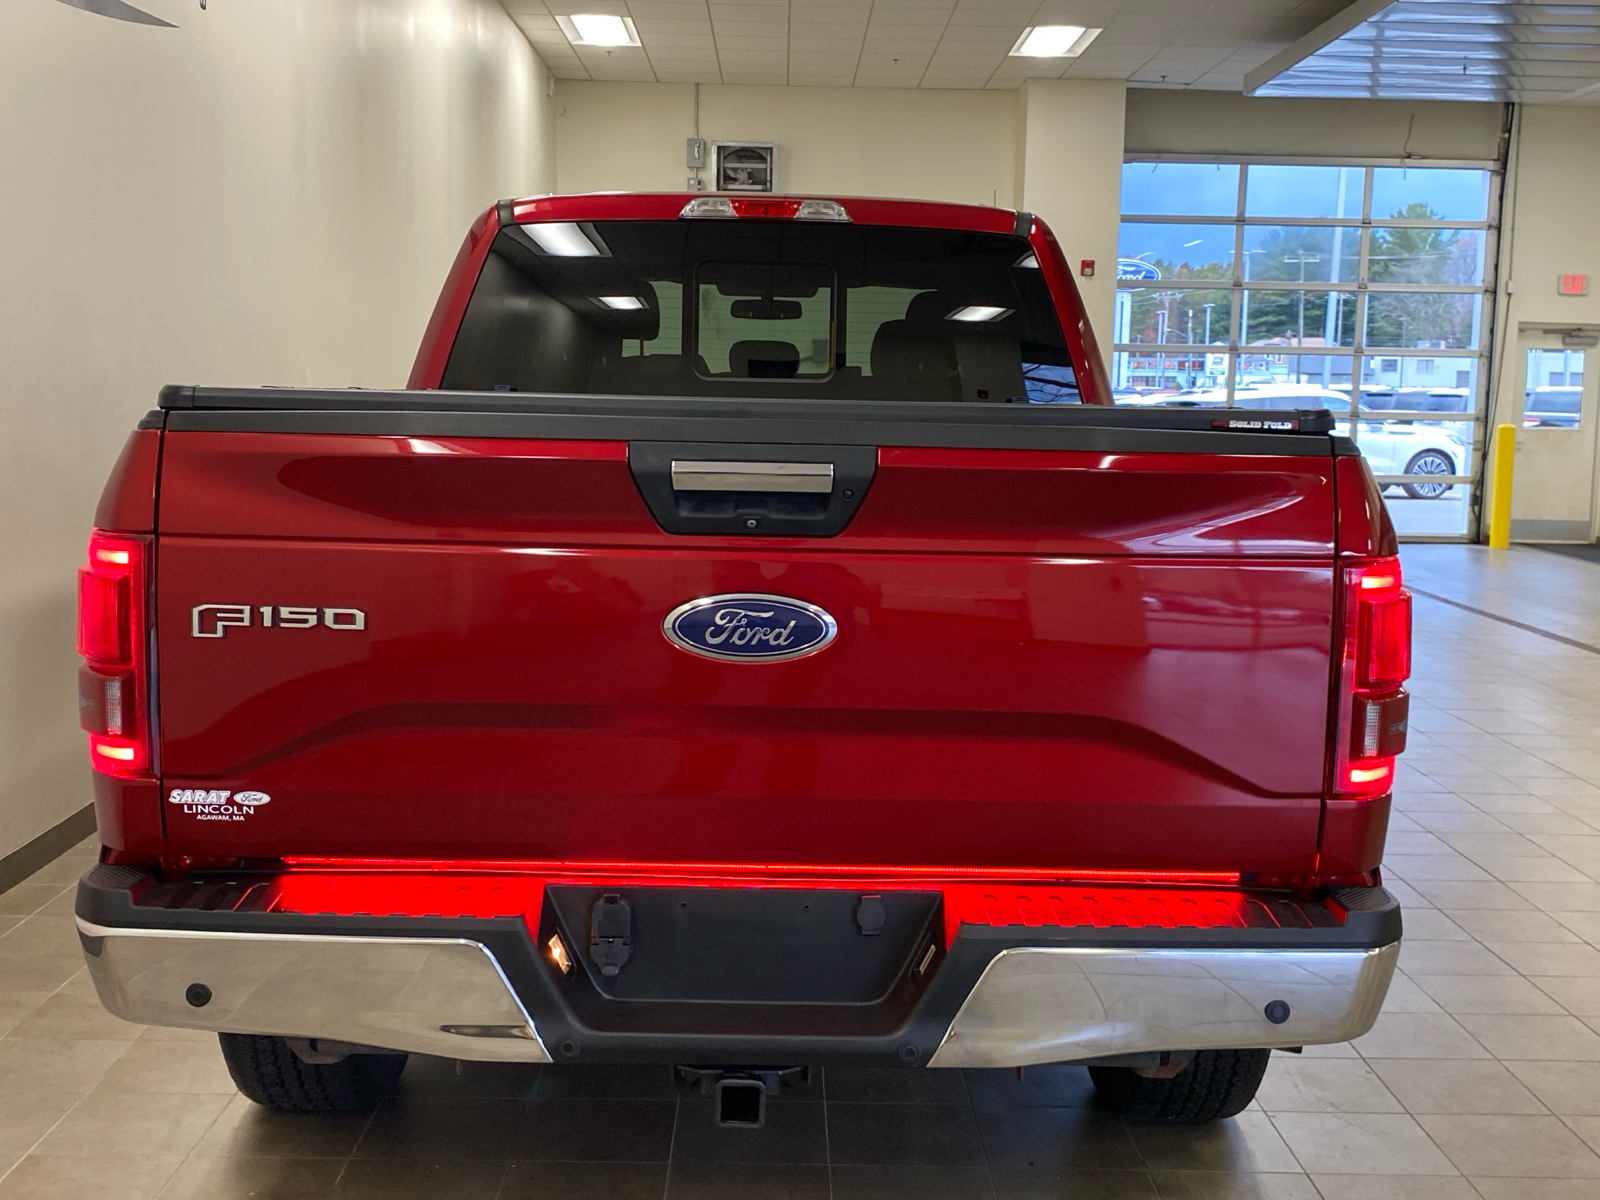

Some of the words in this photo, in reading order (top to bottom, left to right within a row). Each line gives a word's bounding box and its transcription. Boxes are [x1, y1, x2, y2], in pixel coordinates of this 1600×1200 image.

[1563, 274, 1587, 292] EXIT
[1229, 420, 1261, 429] SOLID
[1263, 421, 1292, 430] FOLD
[705, 608, 797, 646] Ford
[169, 789, 231, 804] SARAT
[184, 804, 254, 815] LINCOLN
[197, 814, 231, 822] AGAWAM,
